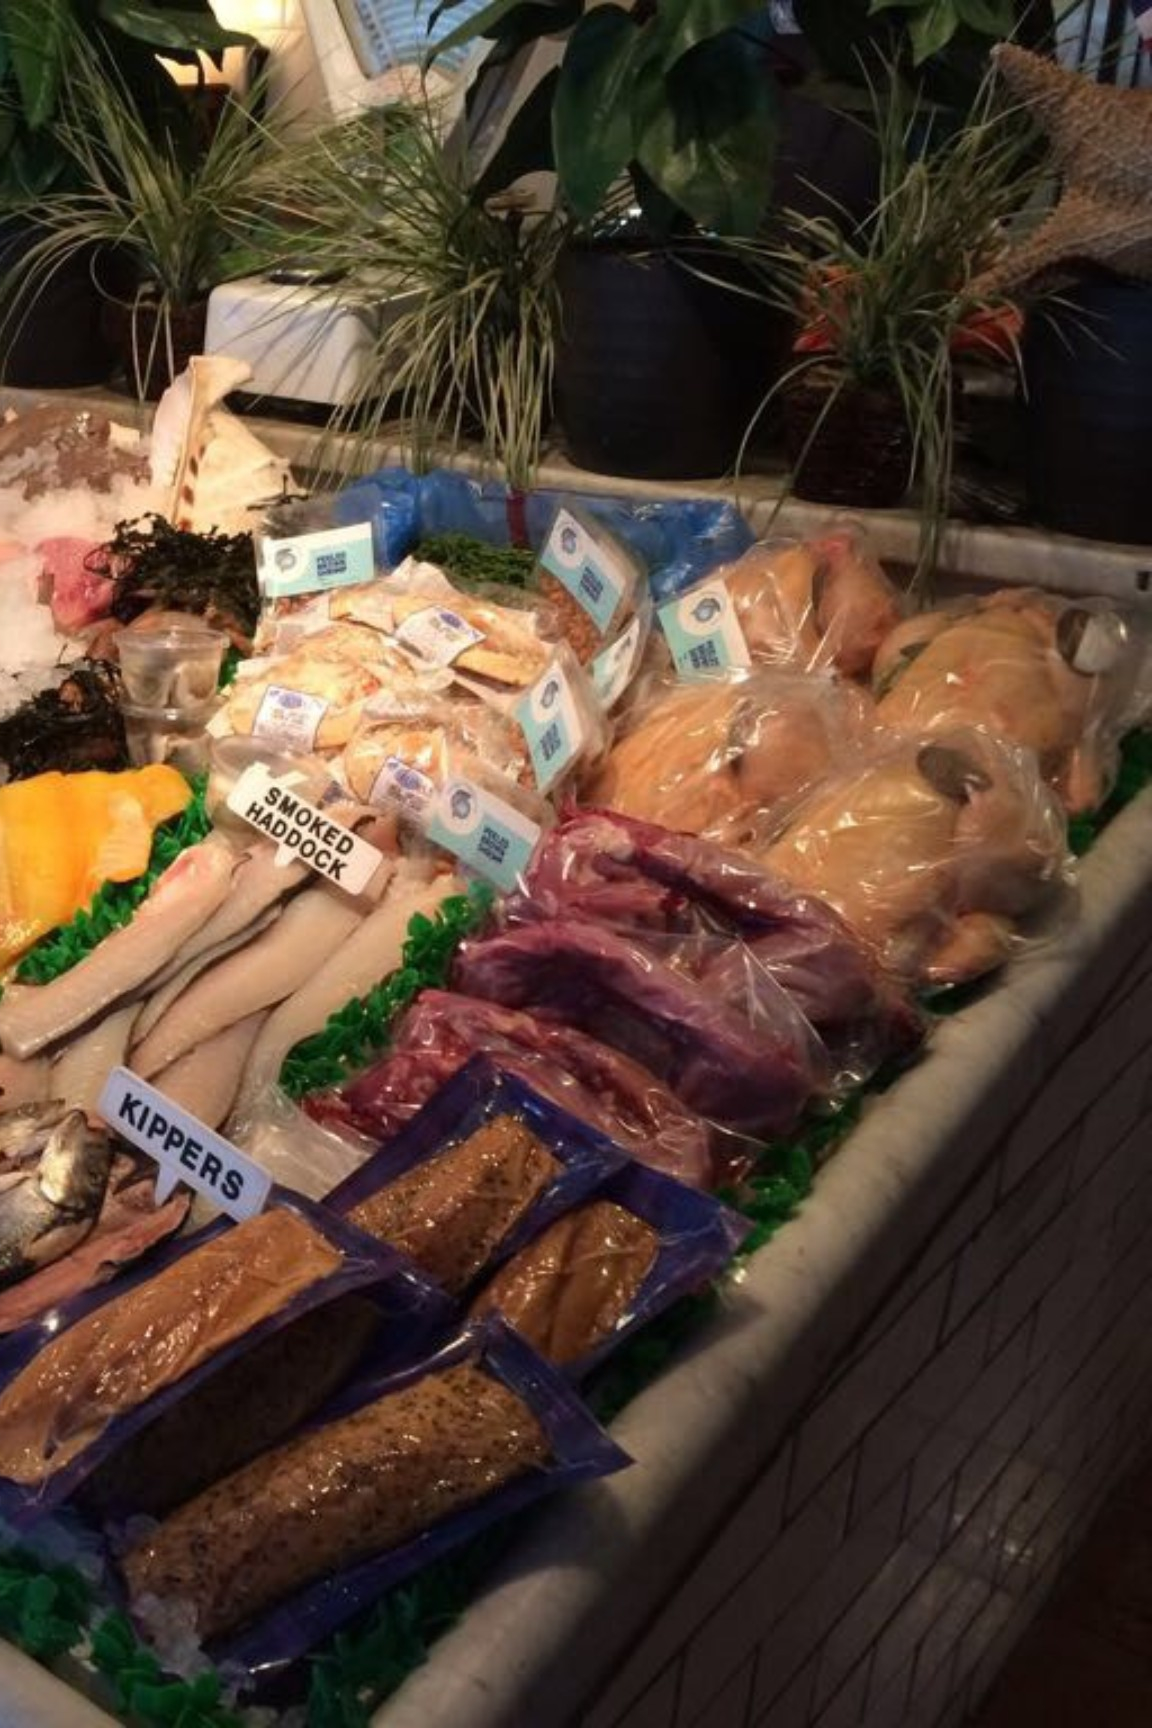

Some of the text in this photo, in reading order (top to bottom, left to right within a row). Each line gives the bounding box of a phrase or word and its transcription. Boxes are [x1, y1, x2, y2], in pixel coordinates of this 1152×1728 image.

[244, 802, 348, 881] HADDOCK
[264, 786, 355, 855] SMOKED
[118, 1092, 246, 1202] KIPPERS
